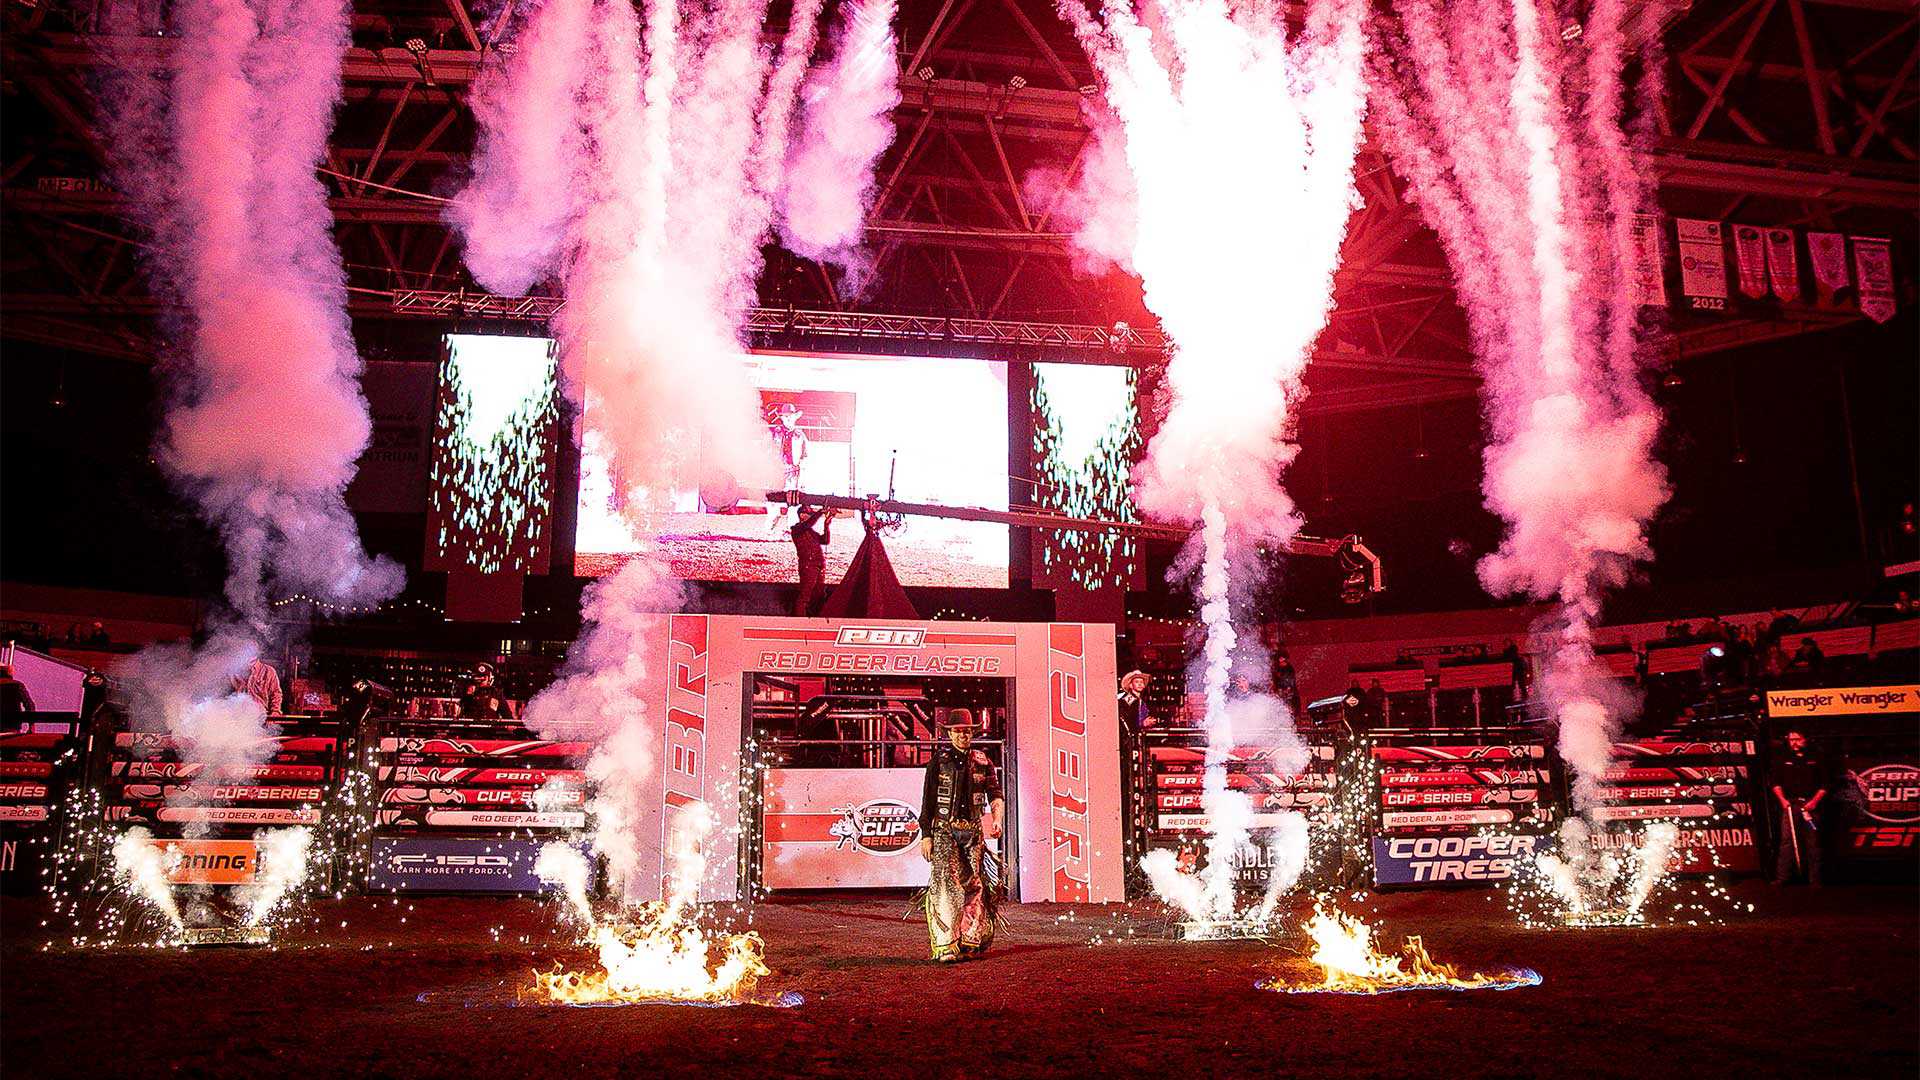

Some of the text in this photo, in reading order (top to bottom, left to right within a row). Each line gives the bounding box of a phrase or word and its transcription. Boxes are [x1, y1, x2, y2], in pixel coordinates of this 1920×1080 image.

[1692, 297, 1724, 310] 2012
[841, 628, 922, 646] PBR
[758, 650, 1000, 674] RED DEER CLASSIC
[1770, 694, 1834, 711] Wrangler
[1840, 691, 1908, 709] Wrangler
[1049, 648, 1090, 882] PBR
[495, 772, 532, 780] PBR
[1871, 772, 1919, 781] PBR
[0, 786, 46, 797] ERIES
[213, 788, 321, 799] CUP SERIES
[477, 791, 510, 802] CUP
[1597, 787, 1676, 799] CUP SERIES
[1868, 787, 1920, 802] CUP
[1163, 796, 1194, 806] CUP
[1387, 793, 1472, 805] CUP SERIES
[227, 811, 258, 820] DEER,
[471, 815, 493, 823] RED
[1410, 815, 1434, 823] DEER,
[861, 822, 906, 836] CUP
[861, 836, 911, 846] SERIES
[1388, 835, 1537, 859] COOPER
[1591, 833, 1633, 849] FOLLOW
[392, 854, 508, 866] F-150
[1409, 858, 1515, 882] TIRES
